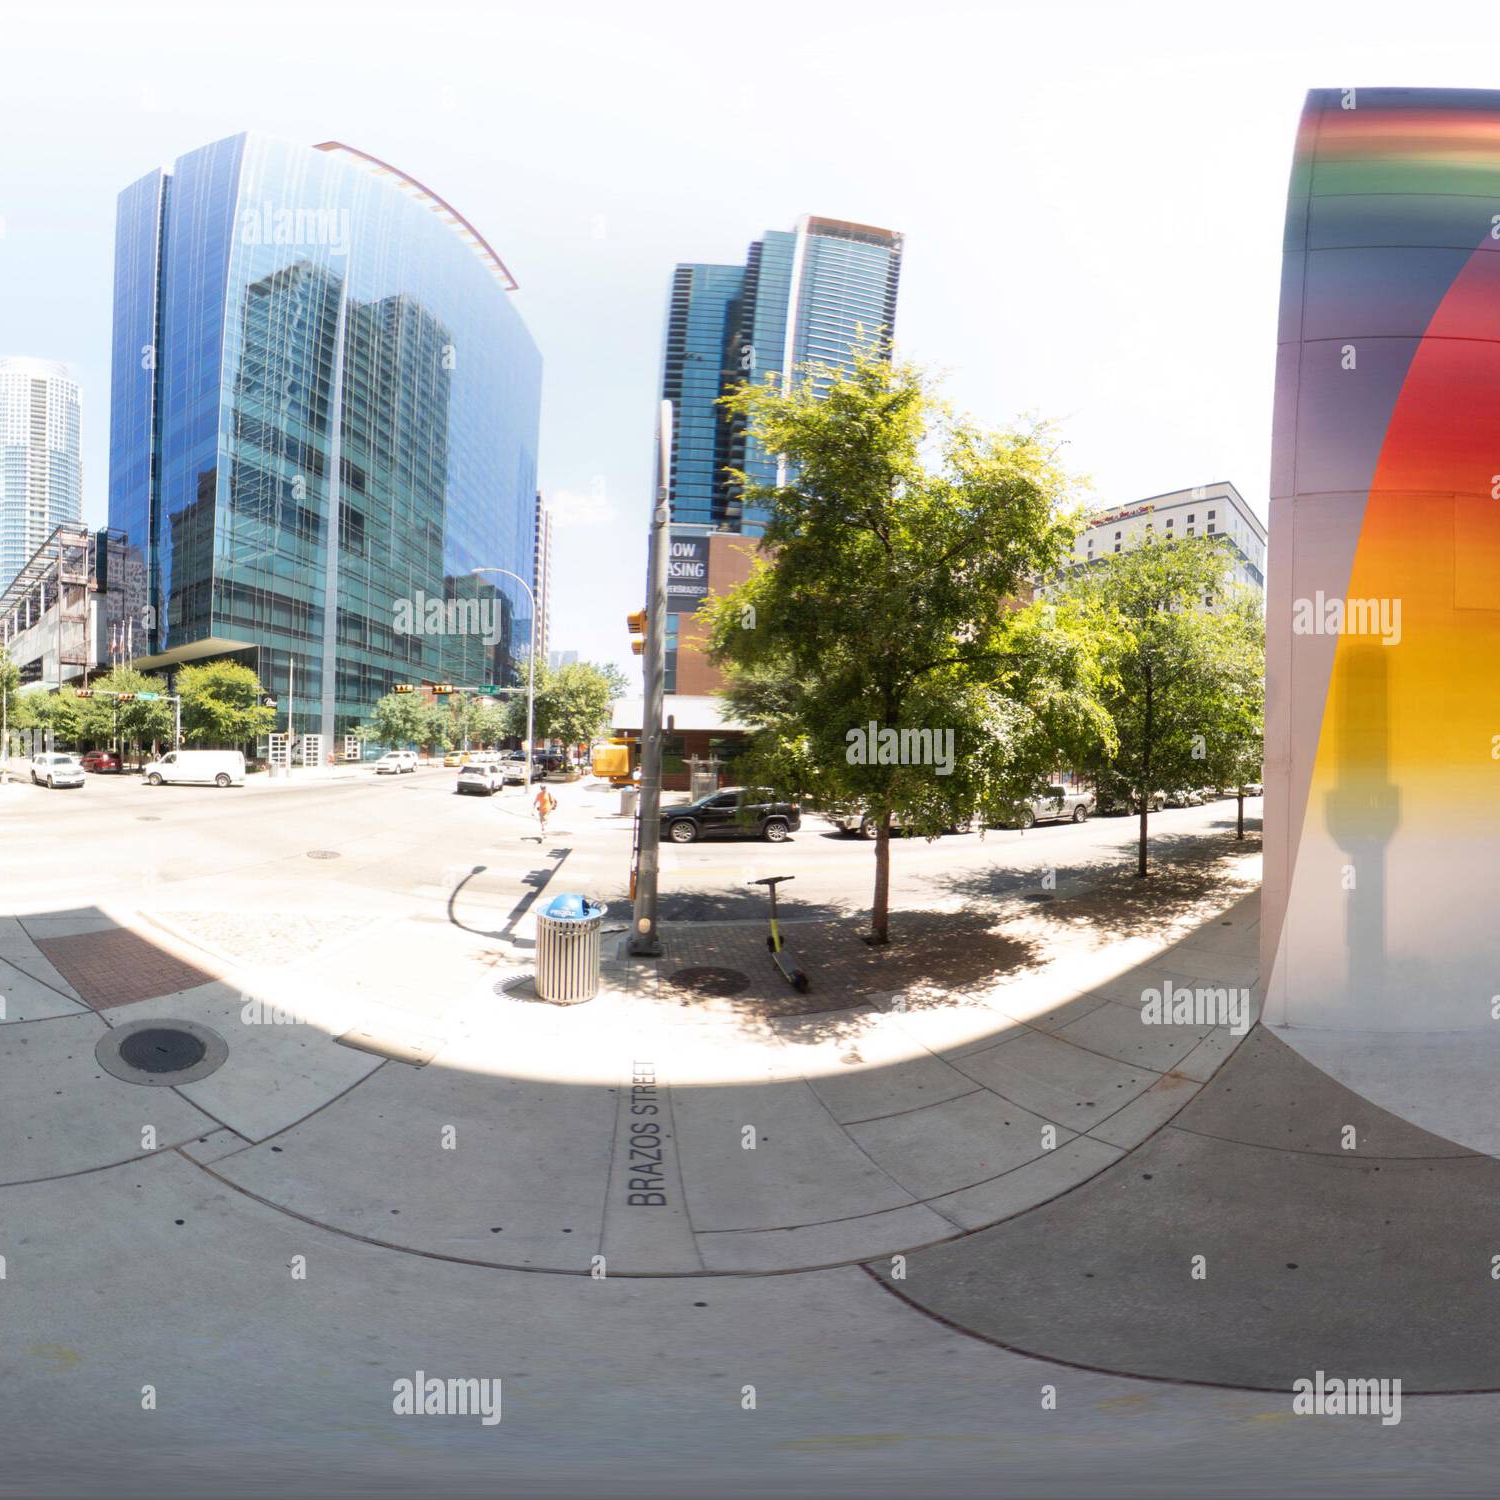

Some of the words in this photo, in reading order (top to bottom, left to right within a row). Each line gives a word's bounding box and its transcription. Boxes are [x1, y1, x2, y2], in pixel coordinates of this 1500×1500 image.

[668, 562, 705, 577] ASING
[631, 1060, 658, 1115] STREET
[627, 1123, 667, 1206] BRAZOS
